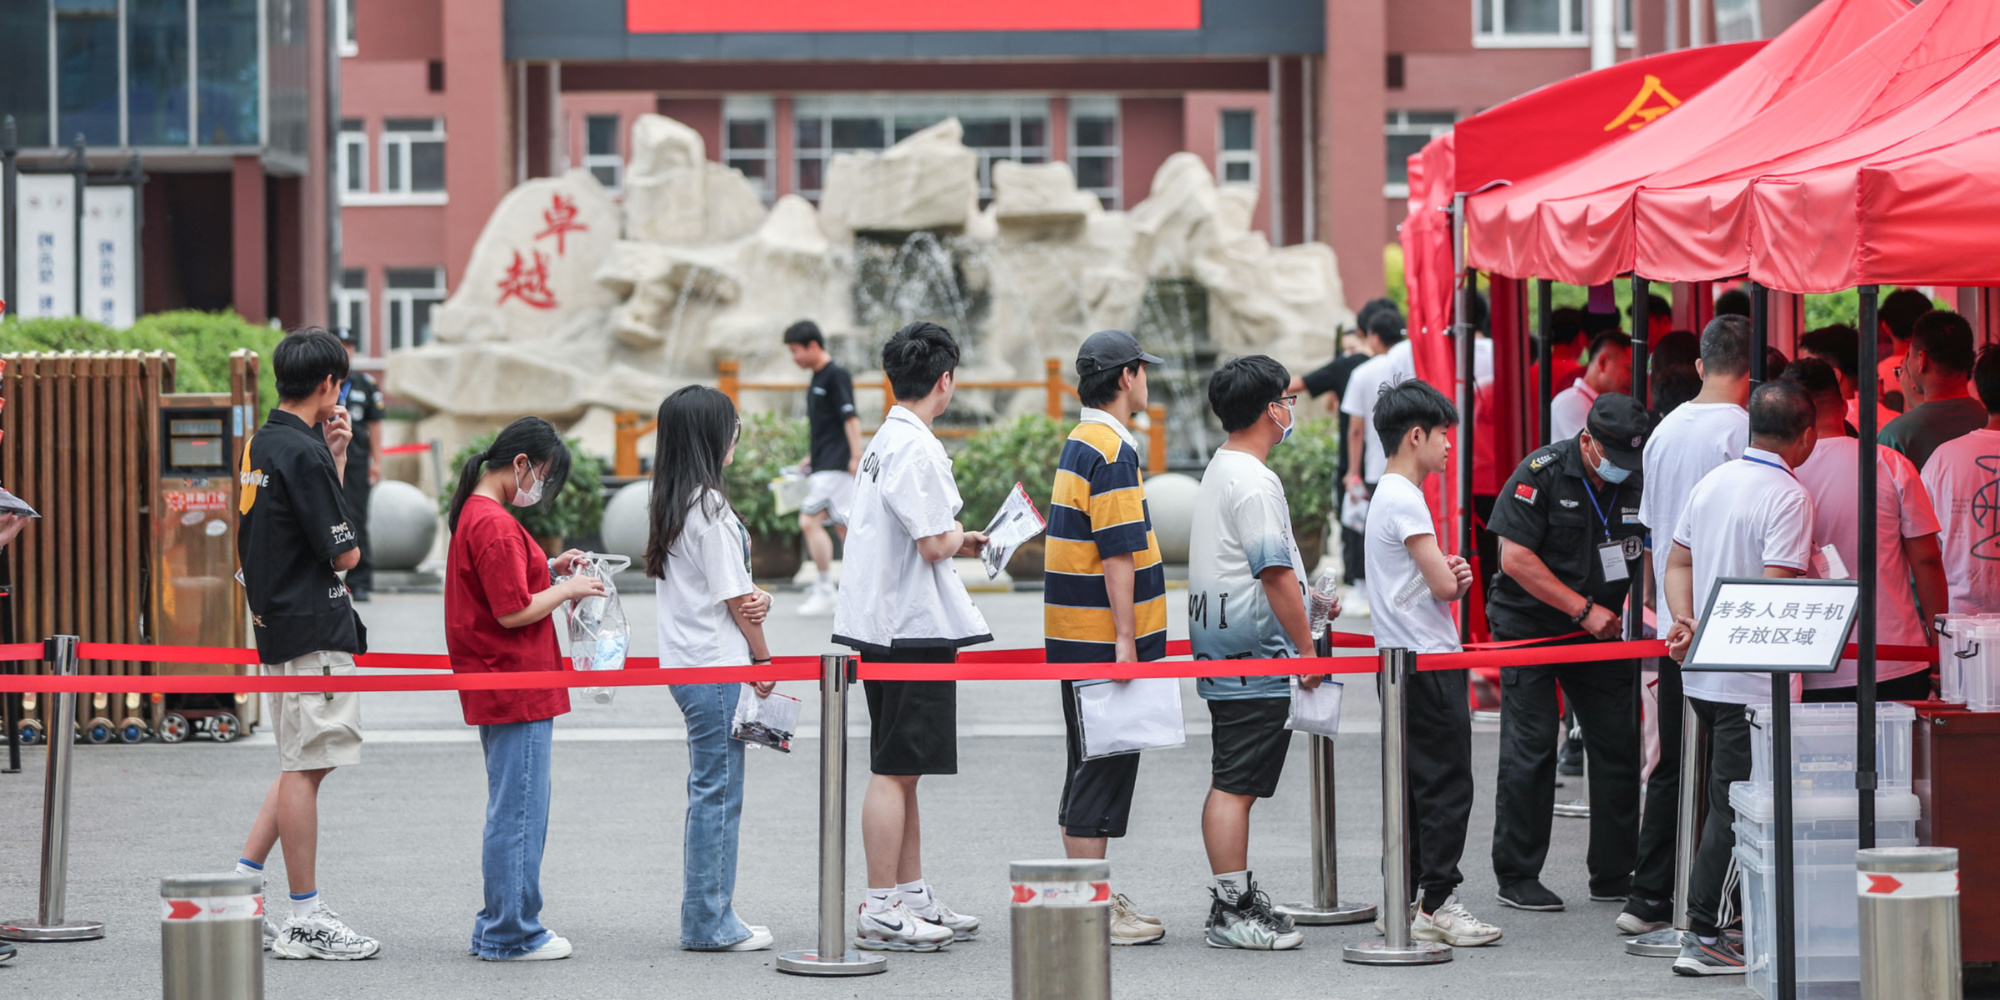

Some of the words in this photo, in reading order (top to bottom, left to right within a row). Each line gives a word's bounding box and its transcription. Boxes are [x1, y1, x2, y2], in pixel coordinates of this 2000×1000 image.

[497, 191, 590, 311] 卓越
[1712, 600, 1845, 621] 考务人员手机
[1727, 625, 1817, 646] 存放区域
